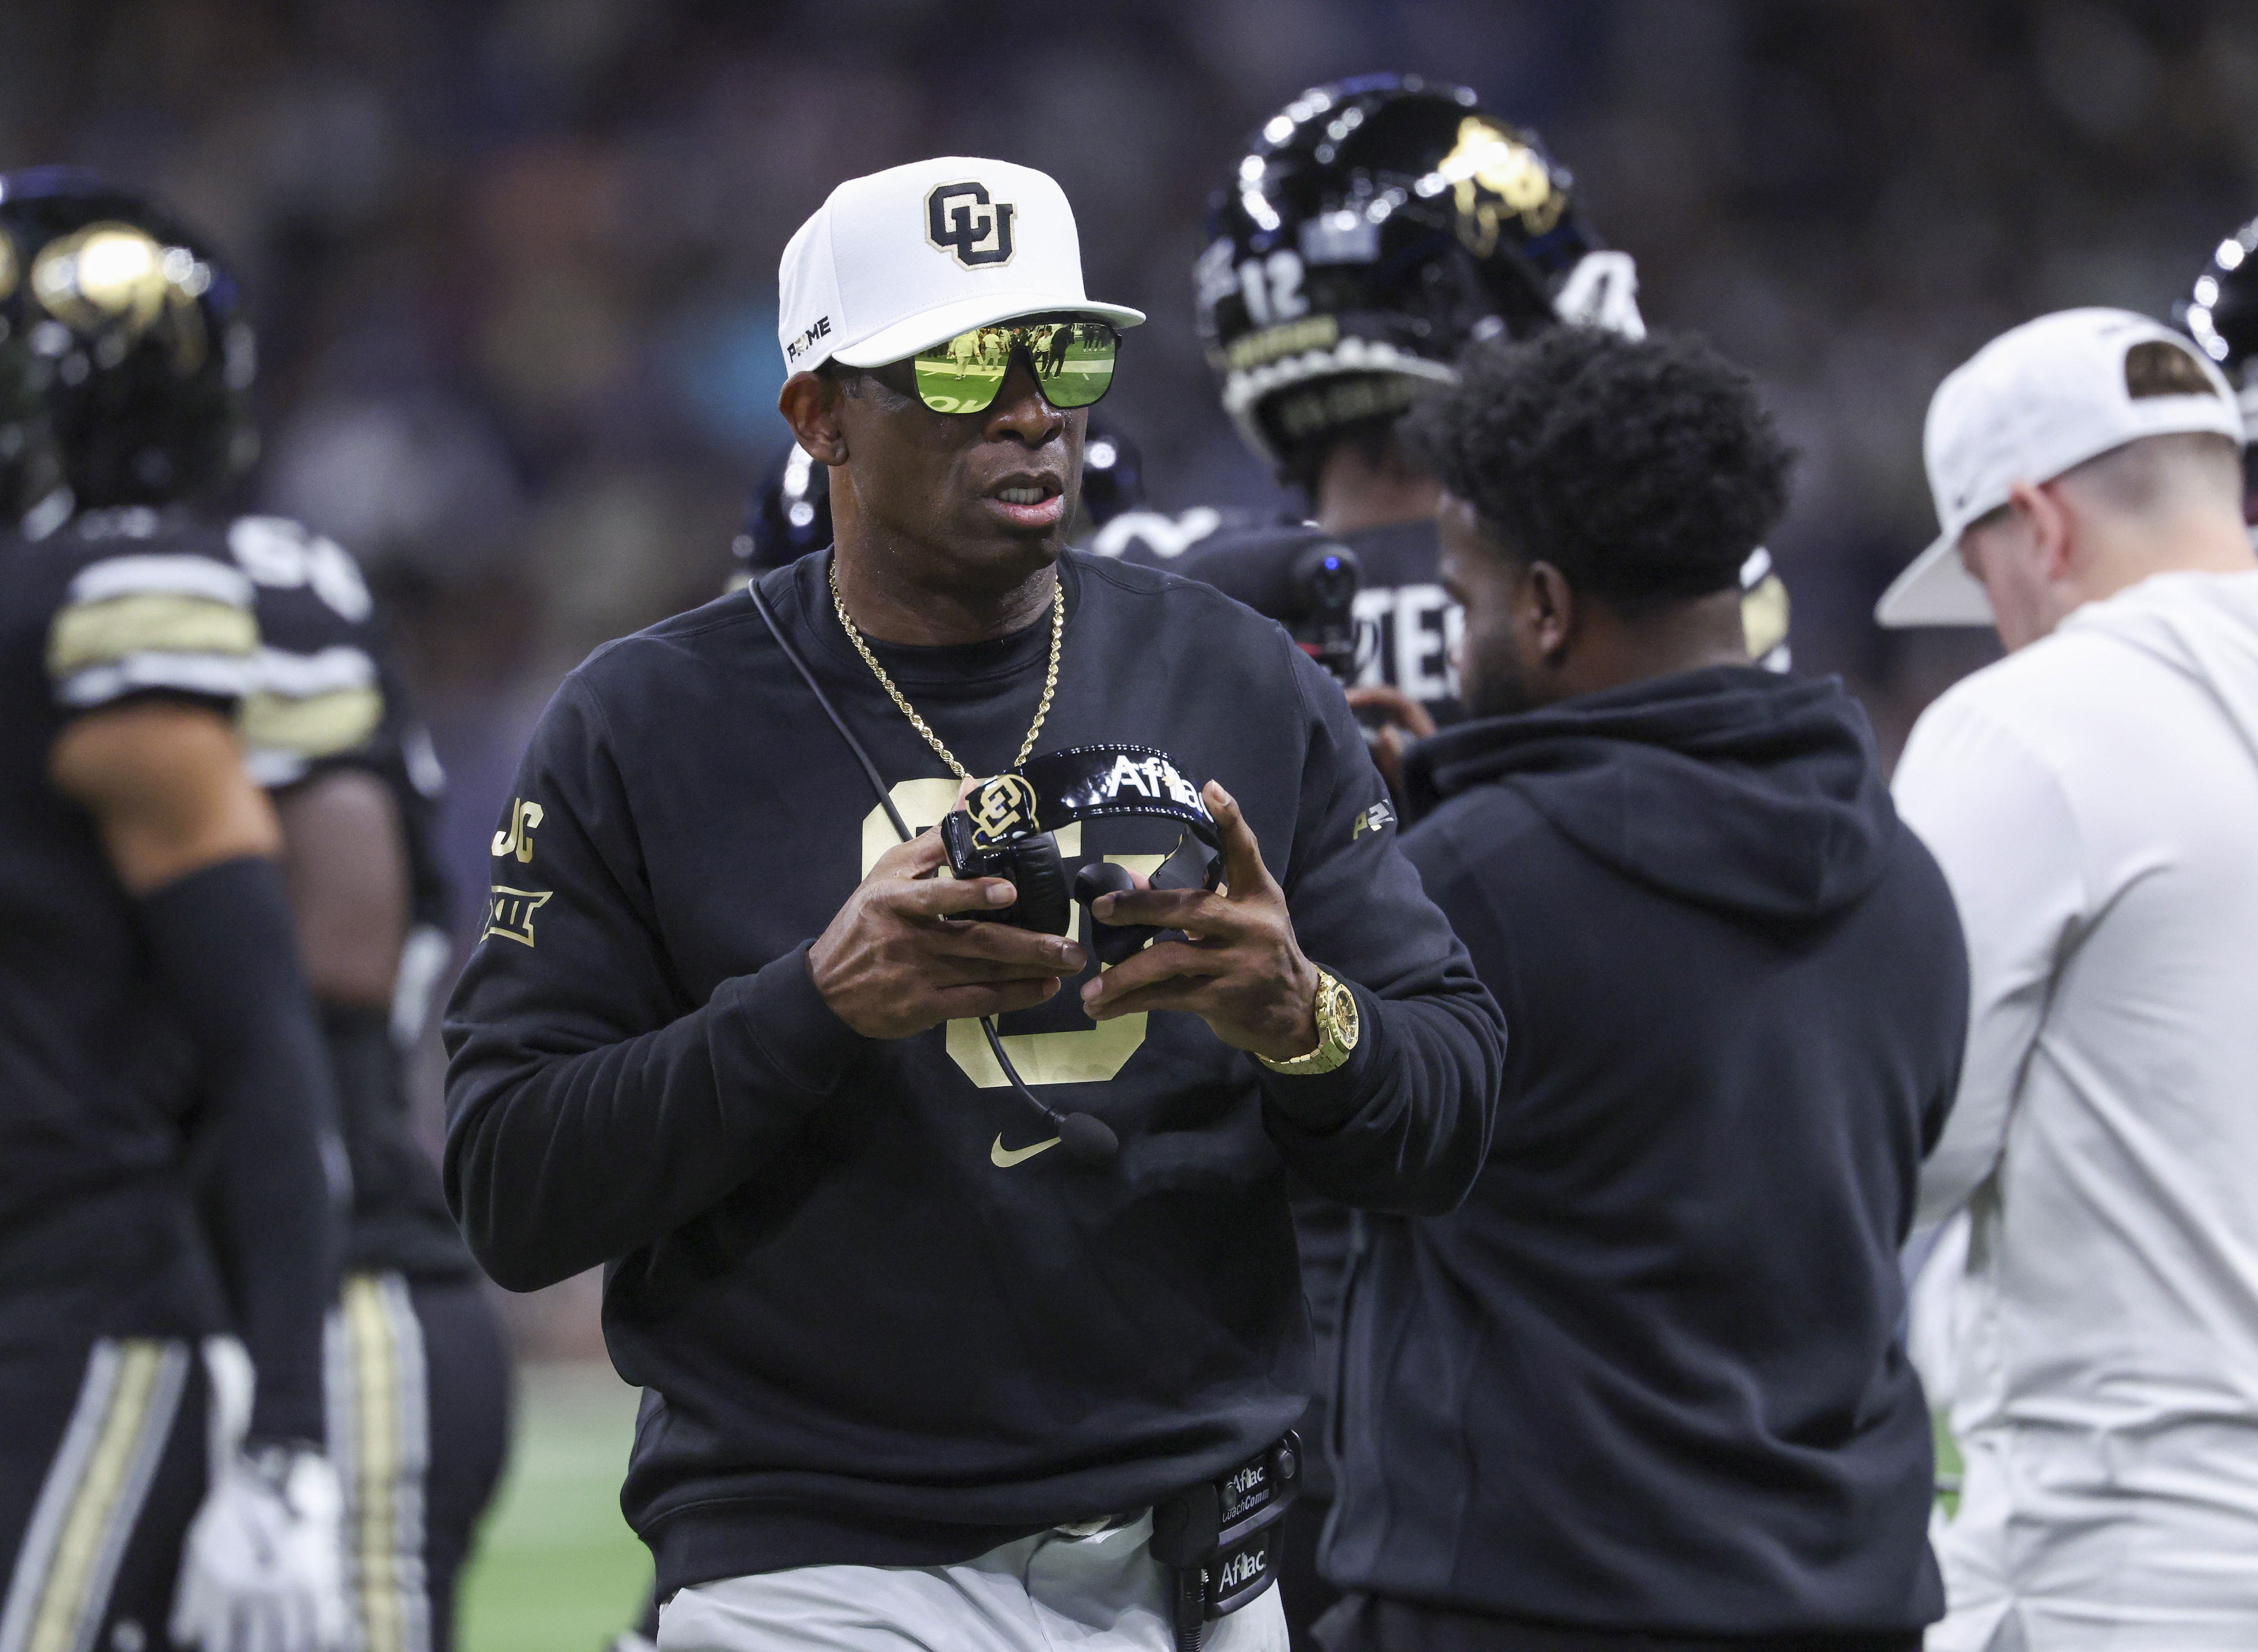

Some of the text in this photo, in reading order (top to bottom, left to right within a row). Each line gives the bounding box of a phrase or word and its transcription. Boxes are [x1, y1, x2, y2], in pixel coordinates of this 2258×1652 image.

[924, 178, 1017, 271] CU
[1239, 250, 1311, 324] 12
[1107, 755, 1214, 823] Afla
[1233, 1466, 1264, 1493] Aflac
[1219, 1550, 1265, 1593] Aflac
